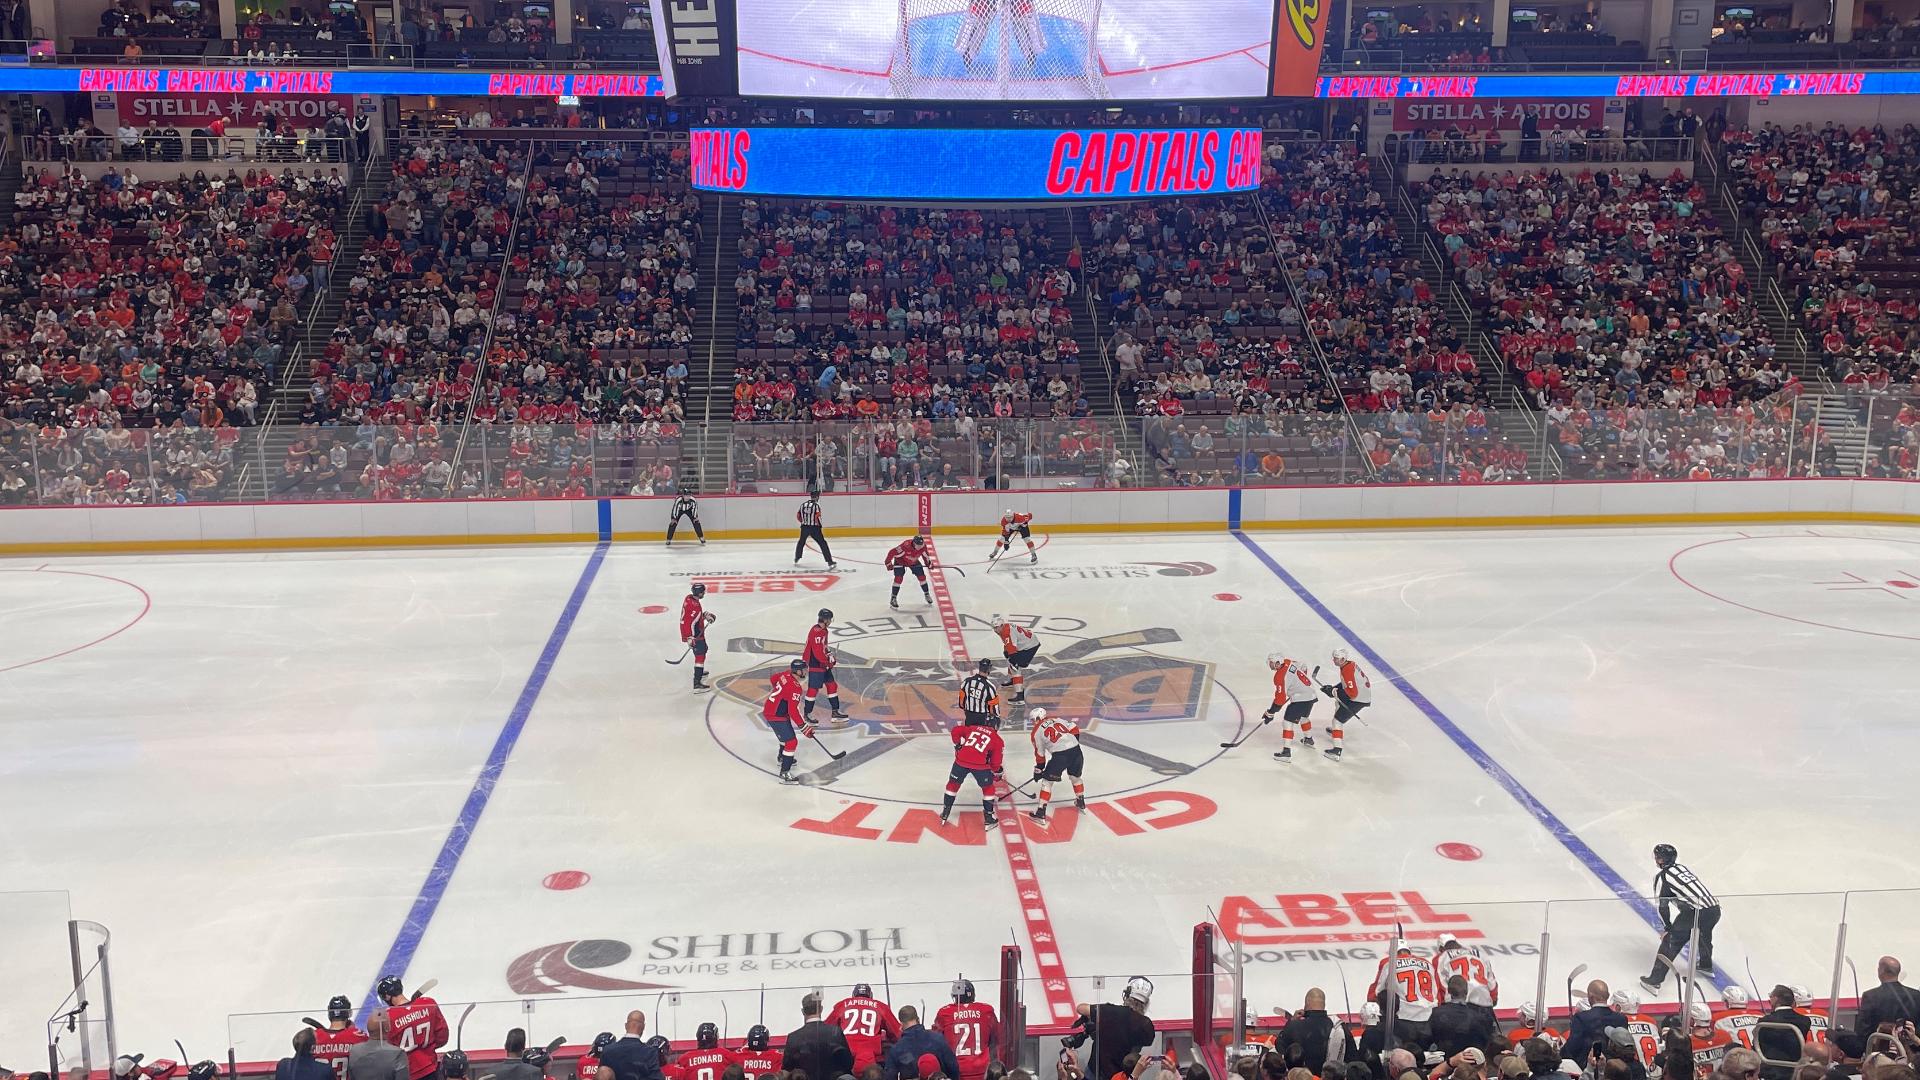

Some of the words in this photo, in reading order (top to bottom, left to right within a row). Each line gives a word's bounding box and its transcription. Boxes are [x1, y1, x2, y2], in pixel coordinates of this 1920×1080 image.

[79, 69, 160, 91] CAPITALS
[166, 69, 247, 92] CAPITALS
[253, 71, 333, 93] PITALS
[488, 74, 565, 95] CAPITALS
[571, 74, 648, 95] CAPITALS
[1328, 76, 1400, 97] CAPITALS
[1404, 76, 1478, 97] PITALS
[1616, 75, 1690, 96] CAPITALS
[1694, 74, 1775, 95] CAPITALS
[1780, 72, 1865, 95] PITALS
[133, 98, 223, 117] STELLA
[1407, 103, 1485, 121] STELLA
[1510, 103, 1591, 120] ARTOIS
[1046, 130, 1219, 195] CAPITALS
[669, 569, 742, 577] SIDING
[1011, 569, 1151, 580] SHILOH
[690, 577, 841, 593] ABEL
[828, 612, 1088, 637] CENTER
[791, 692, 800, 702] 52
[969, 688, 982, 700] 39
[965, 731, 991, 753] 53
[1043, 722, 1070, 743] 20
[788, 790, 1219, 846] GIANT
[1218, 891, 1472, 938] ABEL
[647, 927, 908, 960] SHILOH
[642, 962, 729, 977] Paving
[740, 960, 759, 972] &
[770, 952, 912, 971] Excavating
[1222, 947, 1378, 964] OOFING
[1450, 956, 1489, 986] 73
[1397, 969, 1434, 1003] 78
[844, 999, 878, 1009] LAPIERRE
[394, 1007, 430, 1029] CHISHOLM
[843, 1008, 877, 1037] 29
[953, 1009, 981, 1021] PROTAS
[399, 1021, 431, 1053] 47
[954, 1022, 982, 1057] 21
[688, 1053, 723, 1067] LEONARD
[743, 1059, 772, 1070] PROTAS
